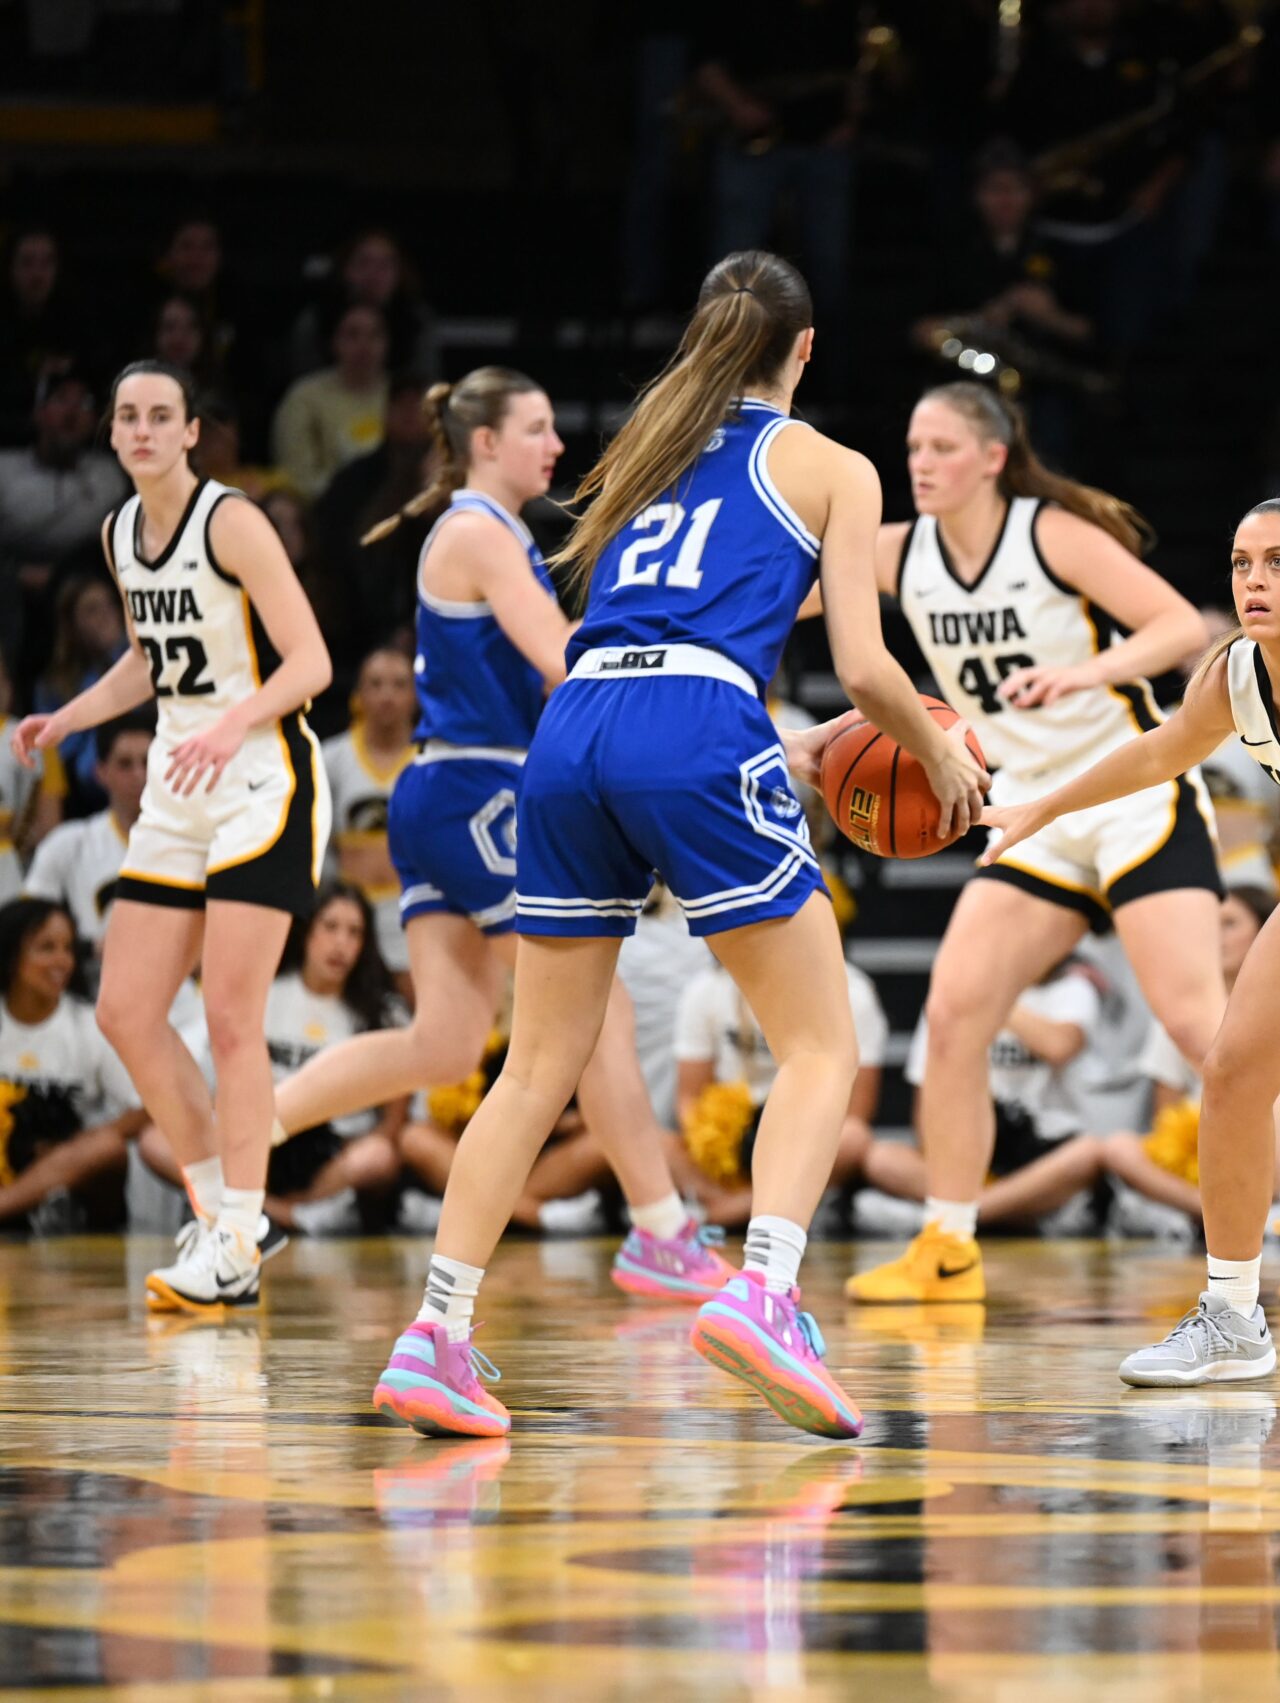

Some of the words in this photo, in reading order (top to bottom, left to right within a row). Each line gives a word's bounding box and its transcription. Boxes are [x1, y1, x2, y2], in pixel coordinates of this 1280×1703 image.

[610, 498, 724, 593] 21
[126, 588, 203, 623] OWA
[929, 607, 1027, 645] IOWA
[138, 636, 216, 696] 22
